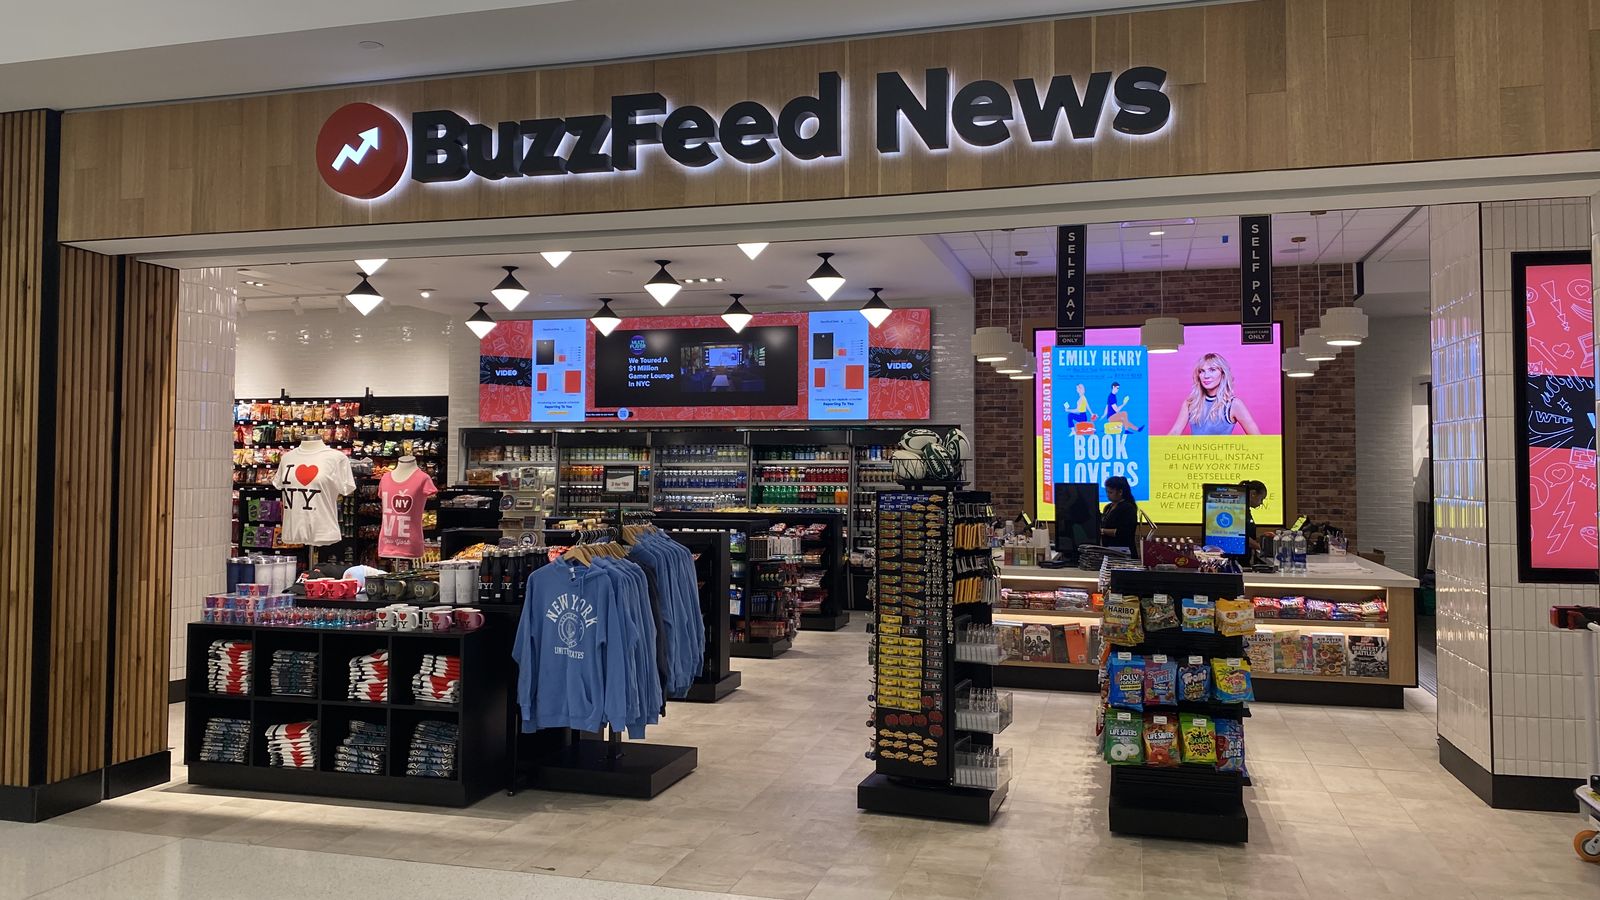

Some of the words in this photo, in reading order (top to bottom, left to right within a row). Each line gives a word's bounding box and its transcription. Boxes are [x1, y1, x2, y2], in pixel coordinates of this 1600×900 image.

[411, 71, 842, 183] BuzzFeed
[876, 66, 1171, 153] News
[1067, 232, 1076, 279] SELF
[1251, 224, 1261, 273] SELF
[1066, 287, 1076, 320] PAY
[1252, 281, 1261, 316] PAY
[1042, 352, 1051, 380] BOOK
[1058, 350, 1098, 366] EMILY
[1102, 350, 1142, 366] HENRY
[1043, 384, 1051, 421] LOVERS
[1535, 410, 1573, 424] WTF
[1043, 428, 1051, 456] EMILY
[1074, 434, 1128, 460] BOOK
[1192, 444, 1249, 452] INSIGHTFUL,
[1164, 453, 1223, 461] DELIGHTFUL,
[282, 464, 294, 484] I
[282, 488, 322, 510] NY
[395, 500, 408, 508] NY
[546, 593, 568, 623] NEW
[571, 594, 598, 628] YORK
[1108, 606, 1134, 615] HARIBO
[1229, 741, 1242, 749] AIR
